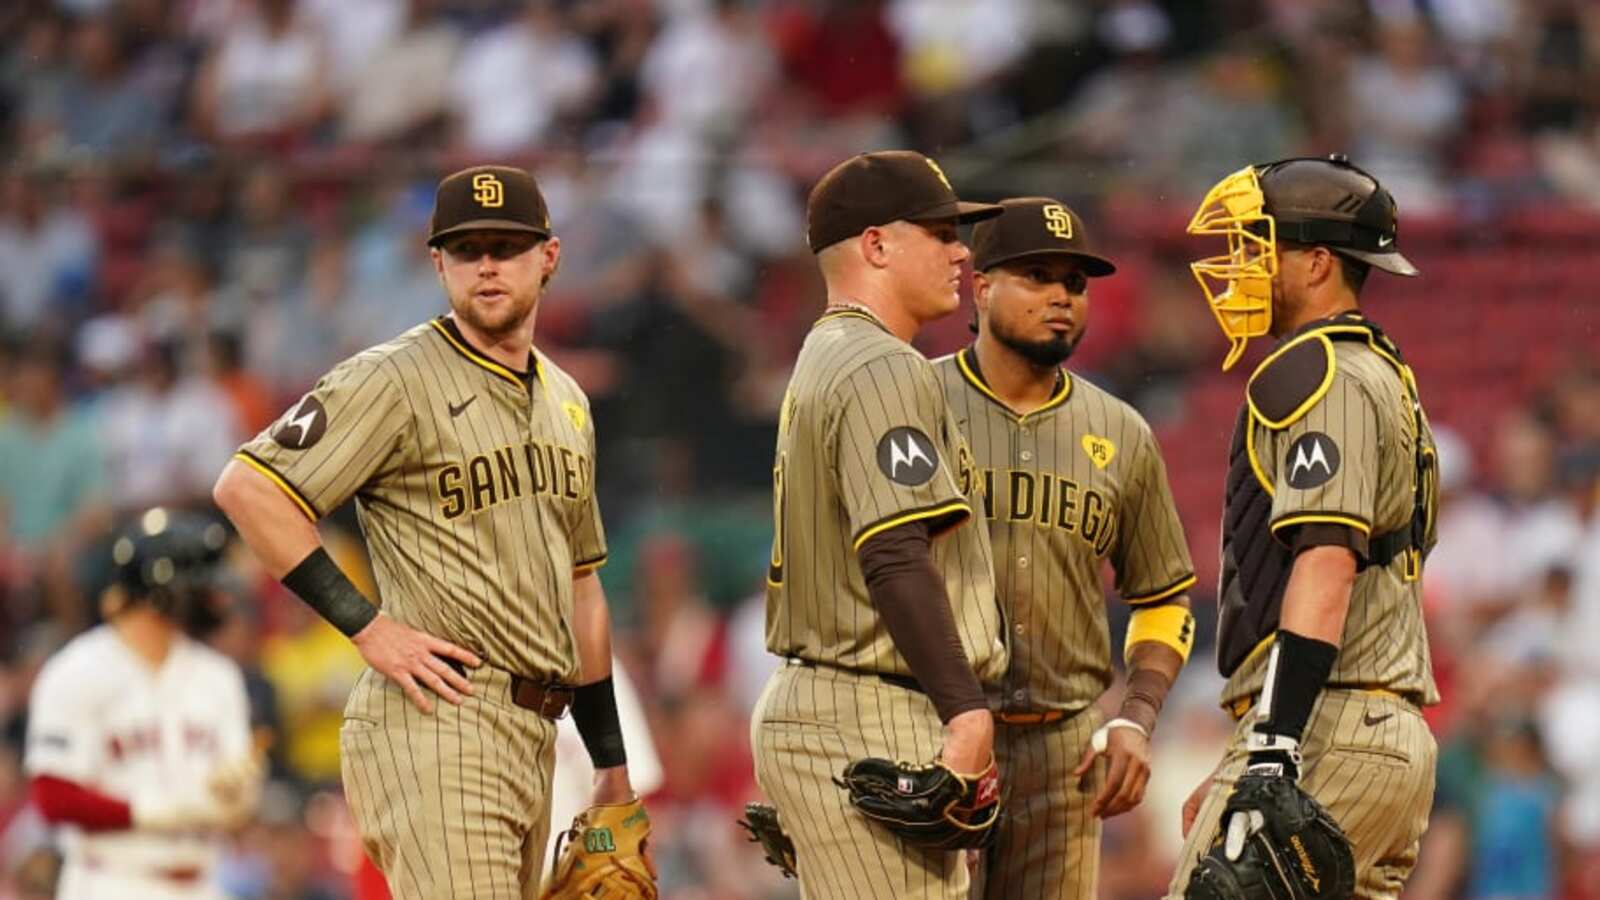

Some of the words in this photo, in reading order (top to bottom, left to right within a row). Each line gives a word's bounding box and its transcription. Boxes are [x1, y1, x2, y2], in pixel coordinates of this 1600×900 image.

[472, 173, 504, 208] SD
[1043, 204, 1073, 240] SD
[436, 446, 521, 520] SAN
[1009, 469, 1115, 557] DIEGO
